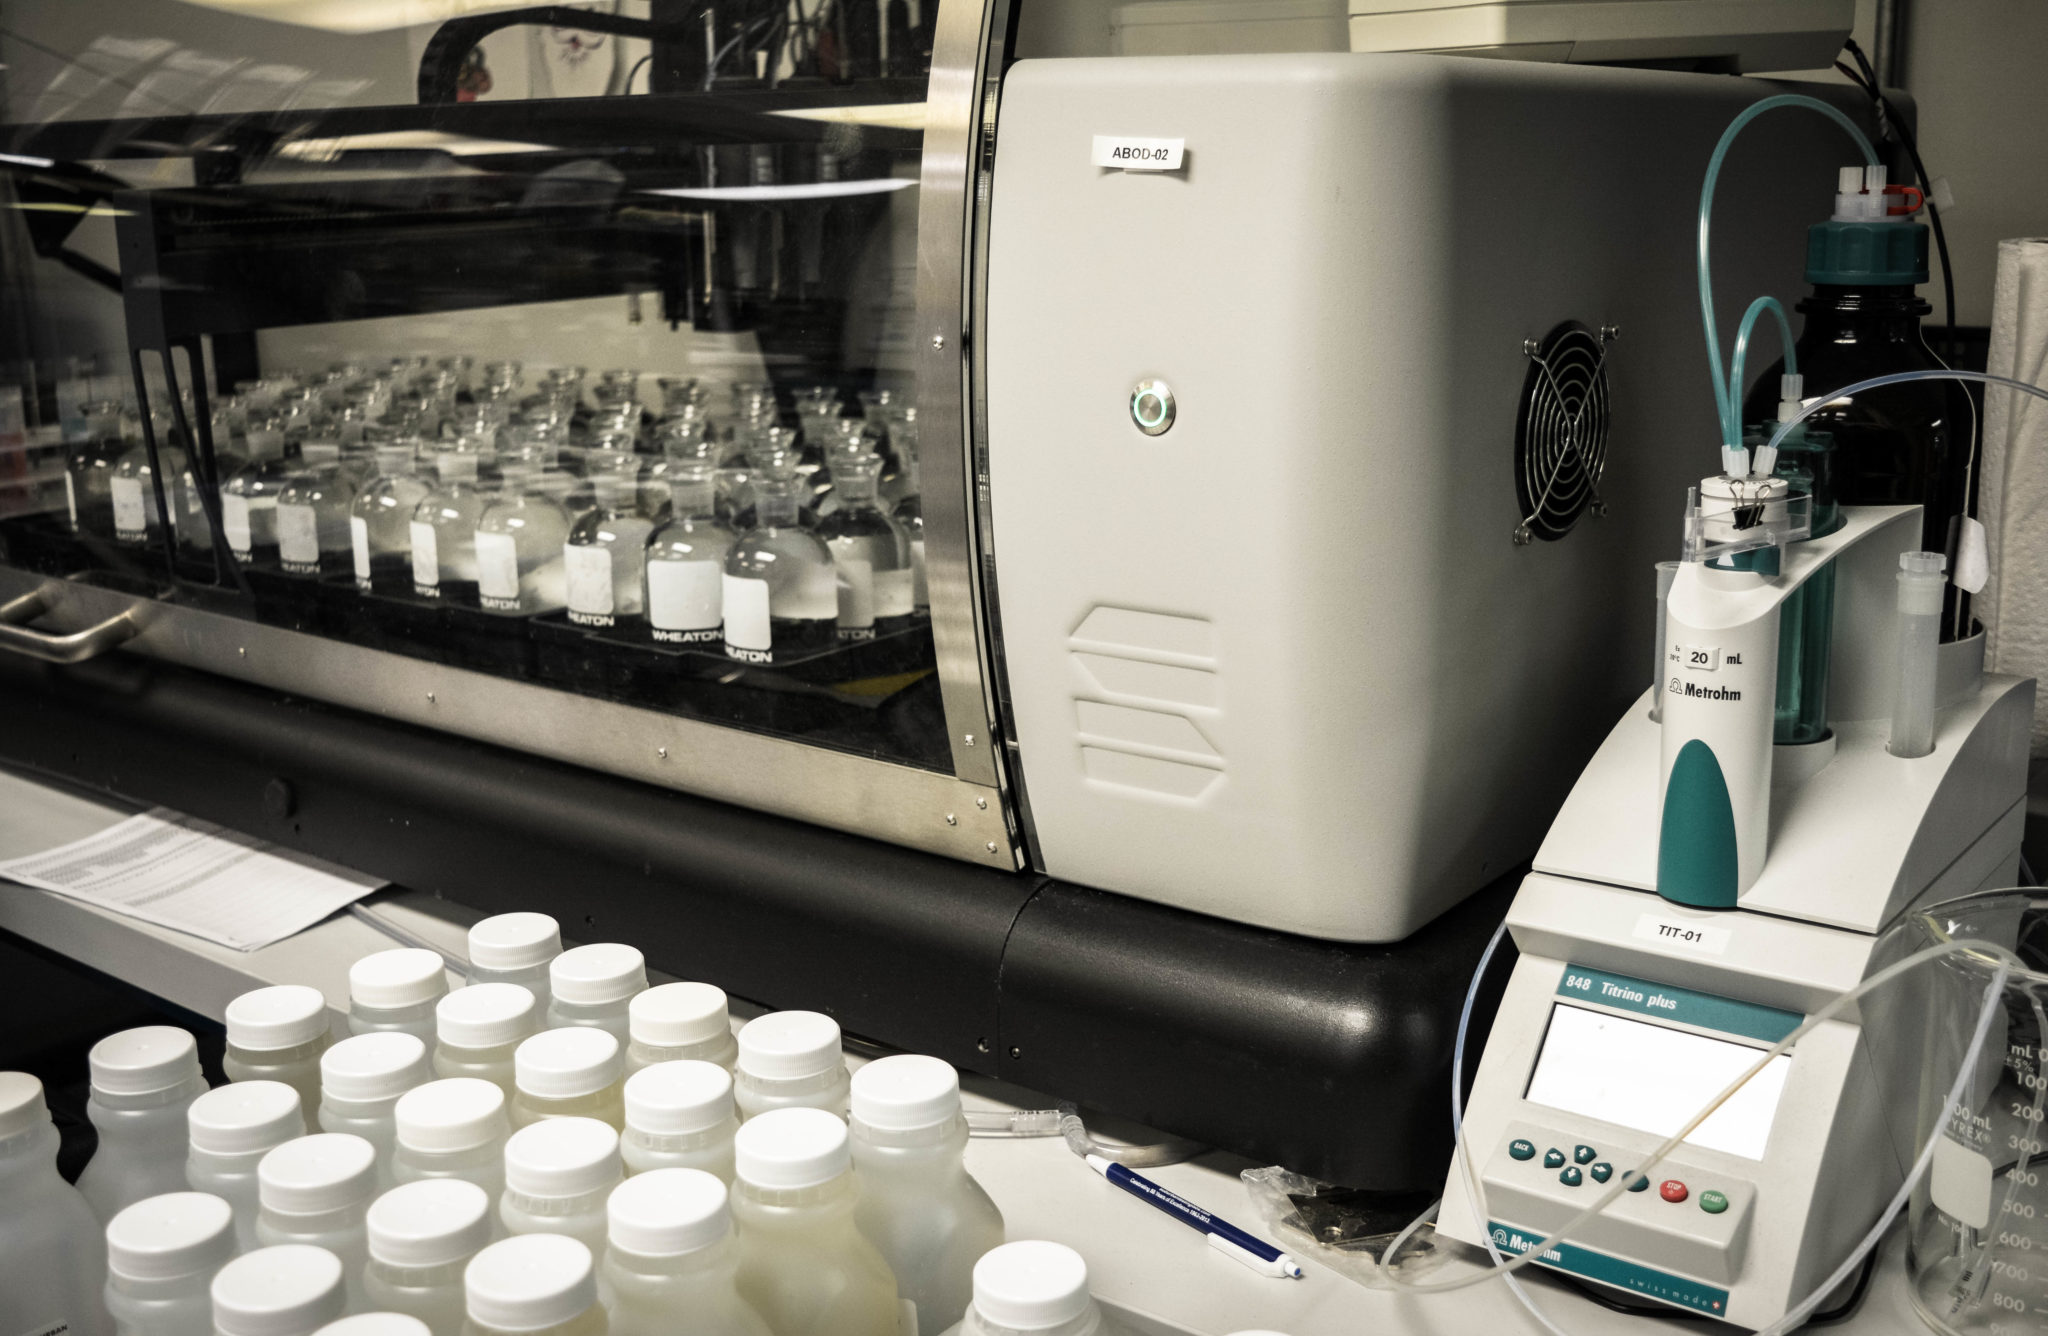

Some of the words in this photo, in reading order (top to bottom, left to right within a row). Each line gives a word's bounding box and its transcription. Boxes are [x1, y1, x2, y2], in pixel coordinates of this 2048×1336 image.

[1112, 147, 1169, 161] ABOD-02
[652, 630, 724, 642] WHEATON
[1691, 651, 1708, 664] 20
[1726, 653, 1743, 665] mL
[1685, 682, 1741, 701] Metrohm
[1657, 923, 1703, 944] TIT-01
[1565, 975, 1591, 992] 848
[1601, 982, 1643, 1004] Titrino
[1646, 992, 1677, 1011] plus
[2011, 1044, 2033, 1059] mL
[2017, 1071, 2047, 1090] 100
[2011, 1102, 2045, 1122] 200
[1973, 1115, 1992, 1131] mL
[1513, 1141, 1529, 1152] BACK
[2008, 1134, 2041, 1154] 300
[1666, 1182, 1682, 1190] STOP
[2005, 1168, 2038, 1188] 400
[1703, 1193, 1722, 1204] START
[2002, 1198, 2035, 1219] 500
[1999, 1231, 2032, 1250] 600
[1995, 1261, 2028, 1281] 700
[1630, 1278, 1667, 1293] swiss
[1672, 1289, 1708, 1307] made
[1992, 1293, 2025, 1312] 800
